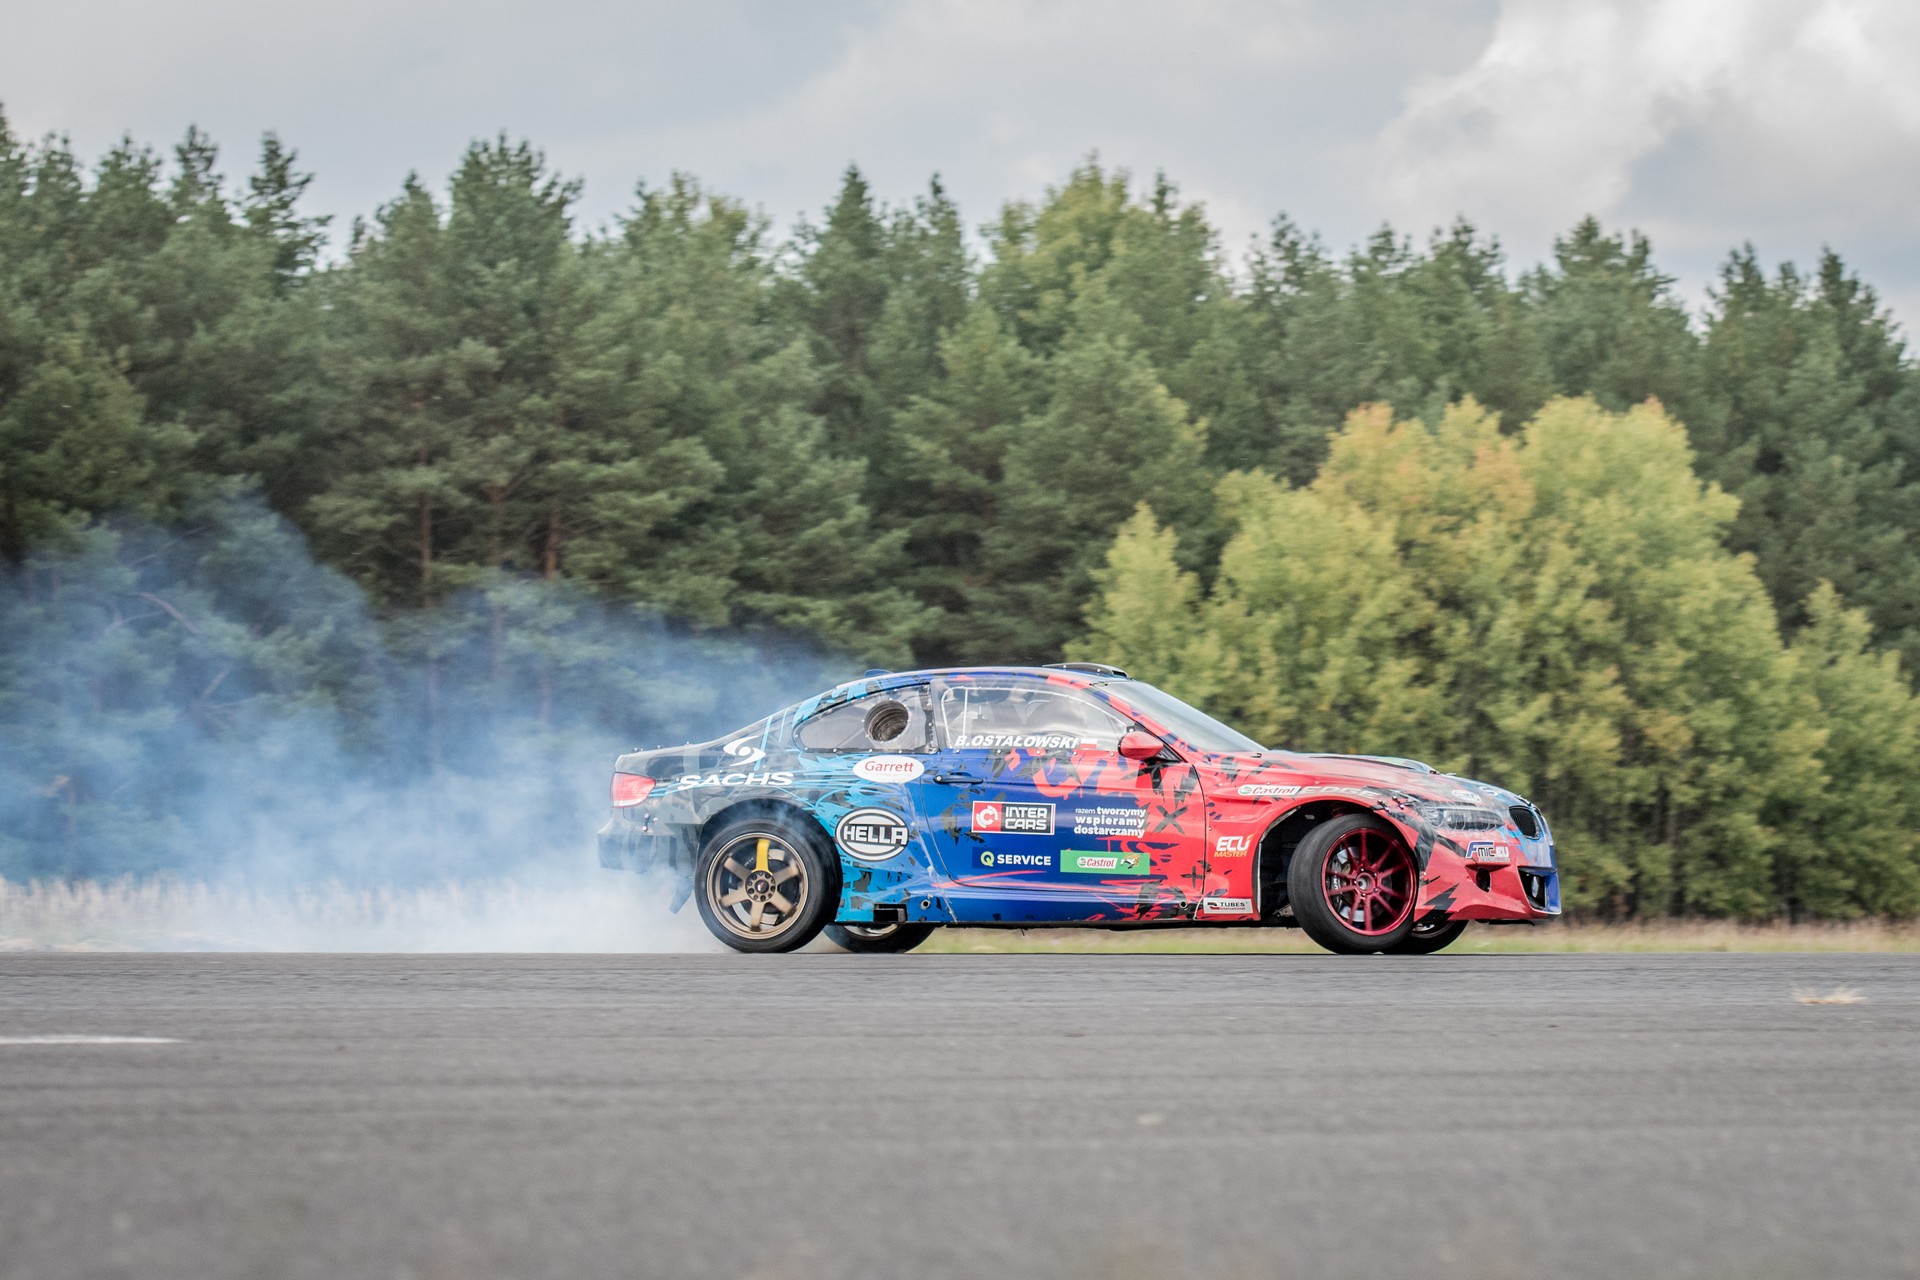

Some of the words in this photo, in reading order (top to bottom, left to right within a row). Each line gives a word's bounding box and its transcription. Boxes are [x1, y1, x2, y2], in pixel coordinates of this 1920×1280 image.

[954, 735, 1080, 748] B.OSTAŁOWSKI
[864, 760, 914, 772] Garrett
[677, 772, 794, 790] SACHS
[1252, 786, 1296, 795] Castrol
[1300, 785, 1382, 799] EDGE
[1005, 806, 1048, 819] INTER
[1096, 806, 1146, 818] tworzymy
[1004, 818, 1047, 830] CARS
[1075, 815, 1145, 828] wspieramy
[843, 825, 908, 846] HELLA
[1073, 825, 1145, 838] dostarczamy
[1216, 834, 1252, 851] ECU
[980, 851, 995, 867] Q
[996, 854, 1052, 866] SERVICE
[1086, 857, 1115, 868] Castrol
